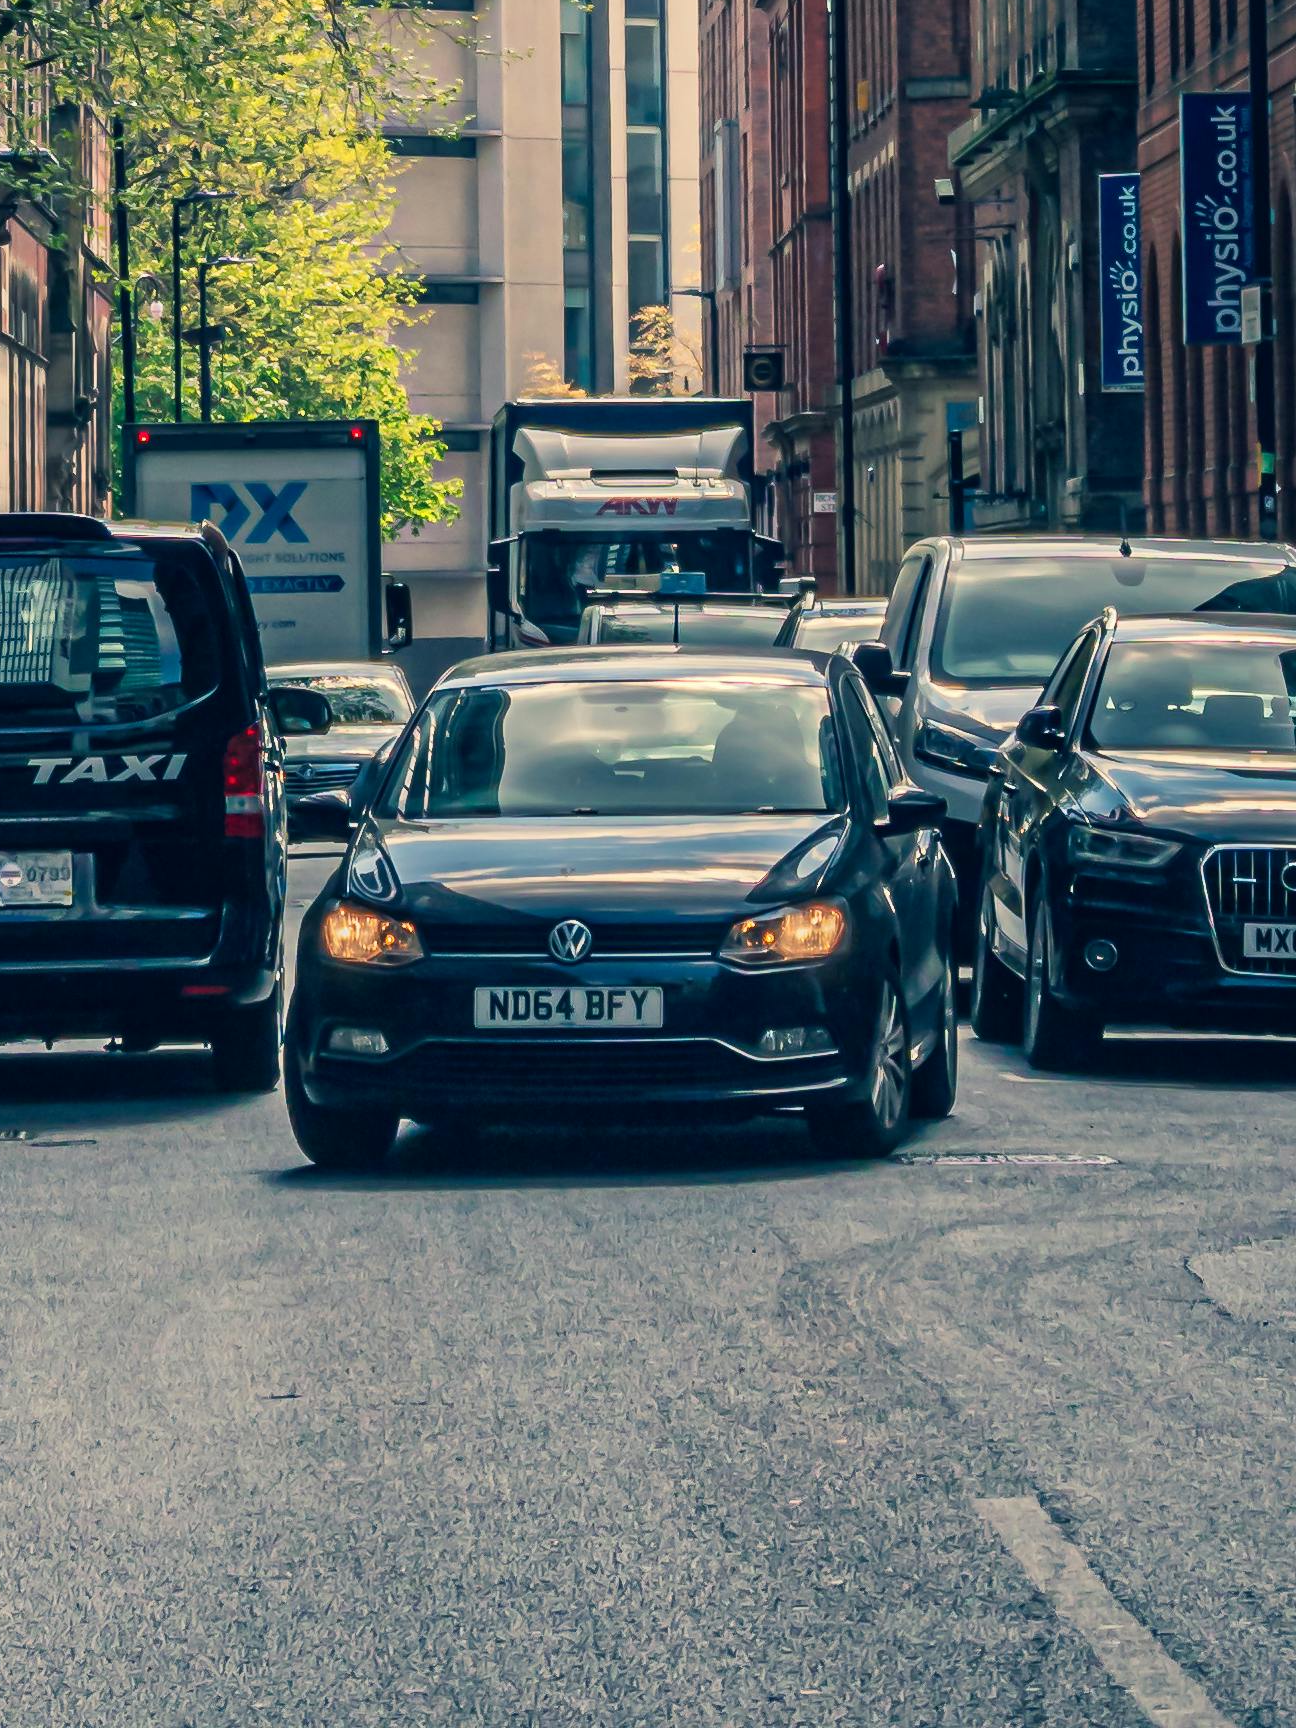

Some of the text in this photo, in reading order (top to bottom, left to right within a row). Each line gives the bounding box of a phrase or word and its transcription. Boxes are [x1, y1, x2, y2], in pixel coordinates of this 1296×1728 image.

[1206, 105, 1246, 333] physio.co.uk
[1116, 185, 1144, 377] physio.co.uk
[274, 552, 345, 563] SOLUTIONS
[262, 579, 332, 591] EXACTLY
[27, 754, 188, 784] TAXI
[489, 990, 648, 1021] ND64 BFY
